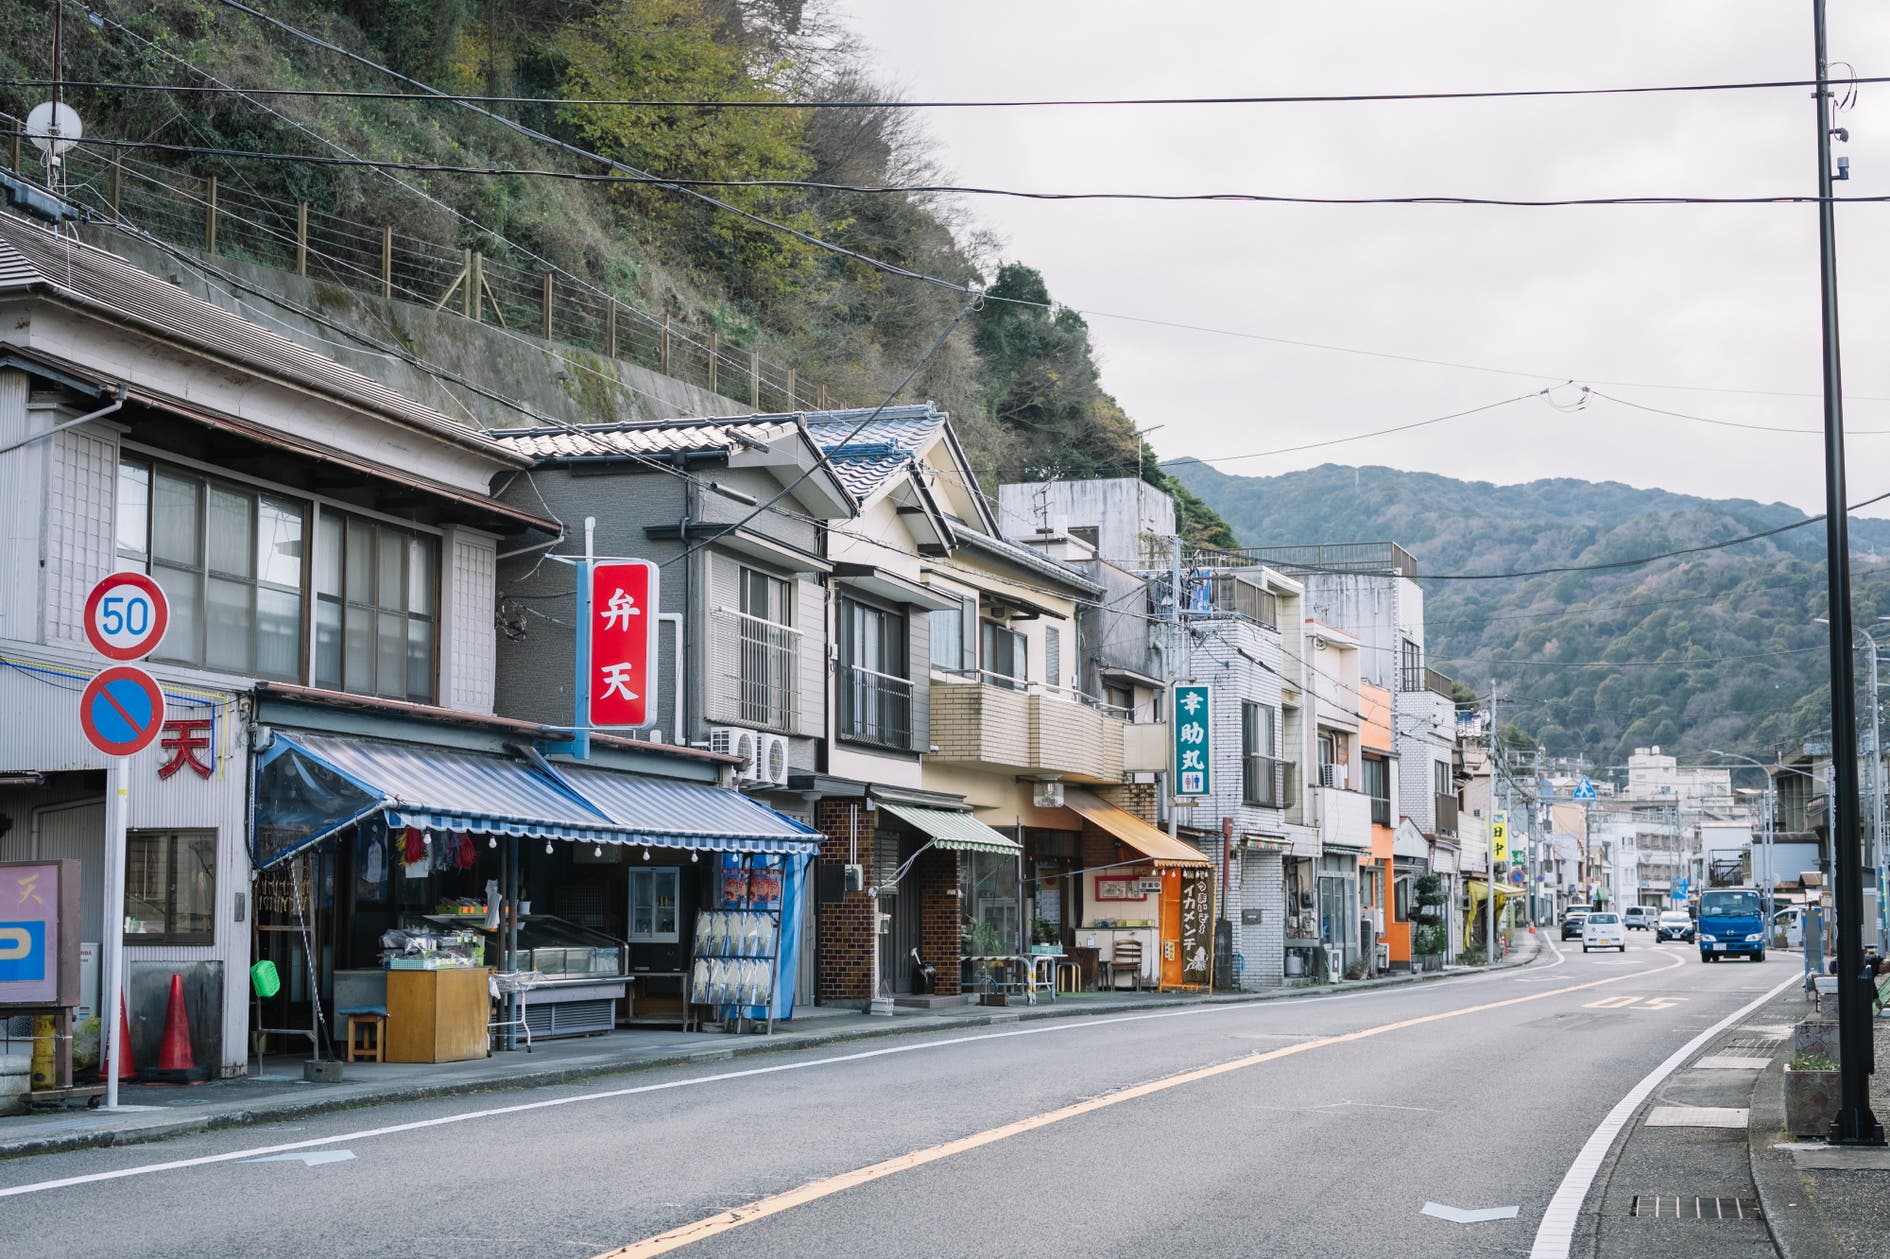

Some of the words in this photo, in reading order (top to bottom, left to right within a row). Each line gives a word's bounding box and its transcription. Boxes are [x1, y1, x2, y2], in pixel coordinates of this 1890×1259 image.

[102, 597, 148, 635] 50
[600, 588, 641, 700] 弁天
[157, 719, 214, 780] 天
[1180, 691, 1205, 770] 幸助丸
[16, 872, 44, 905] 天
